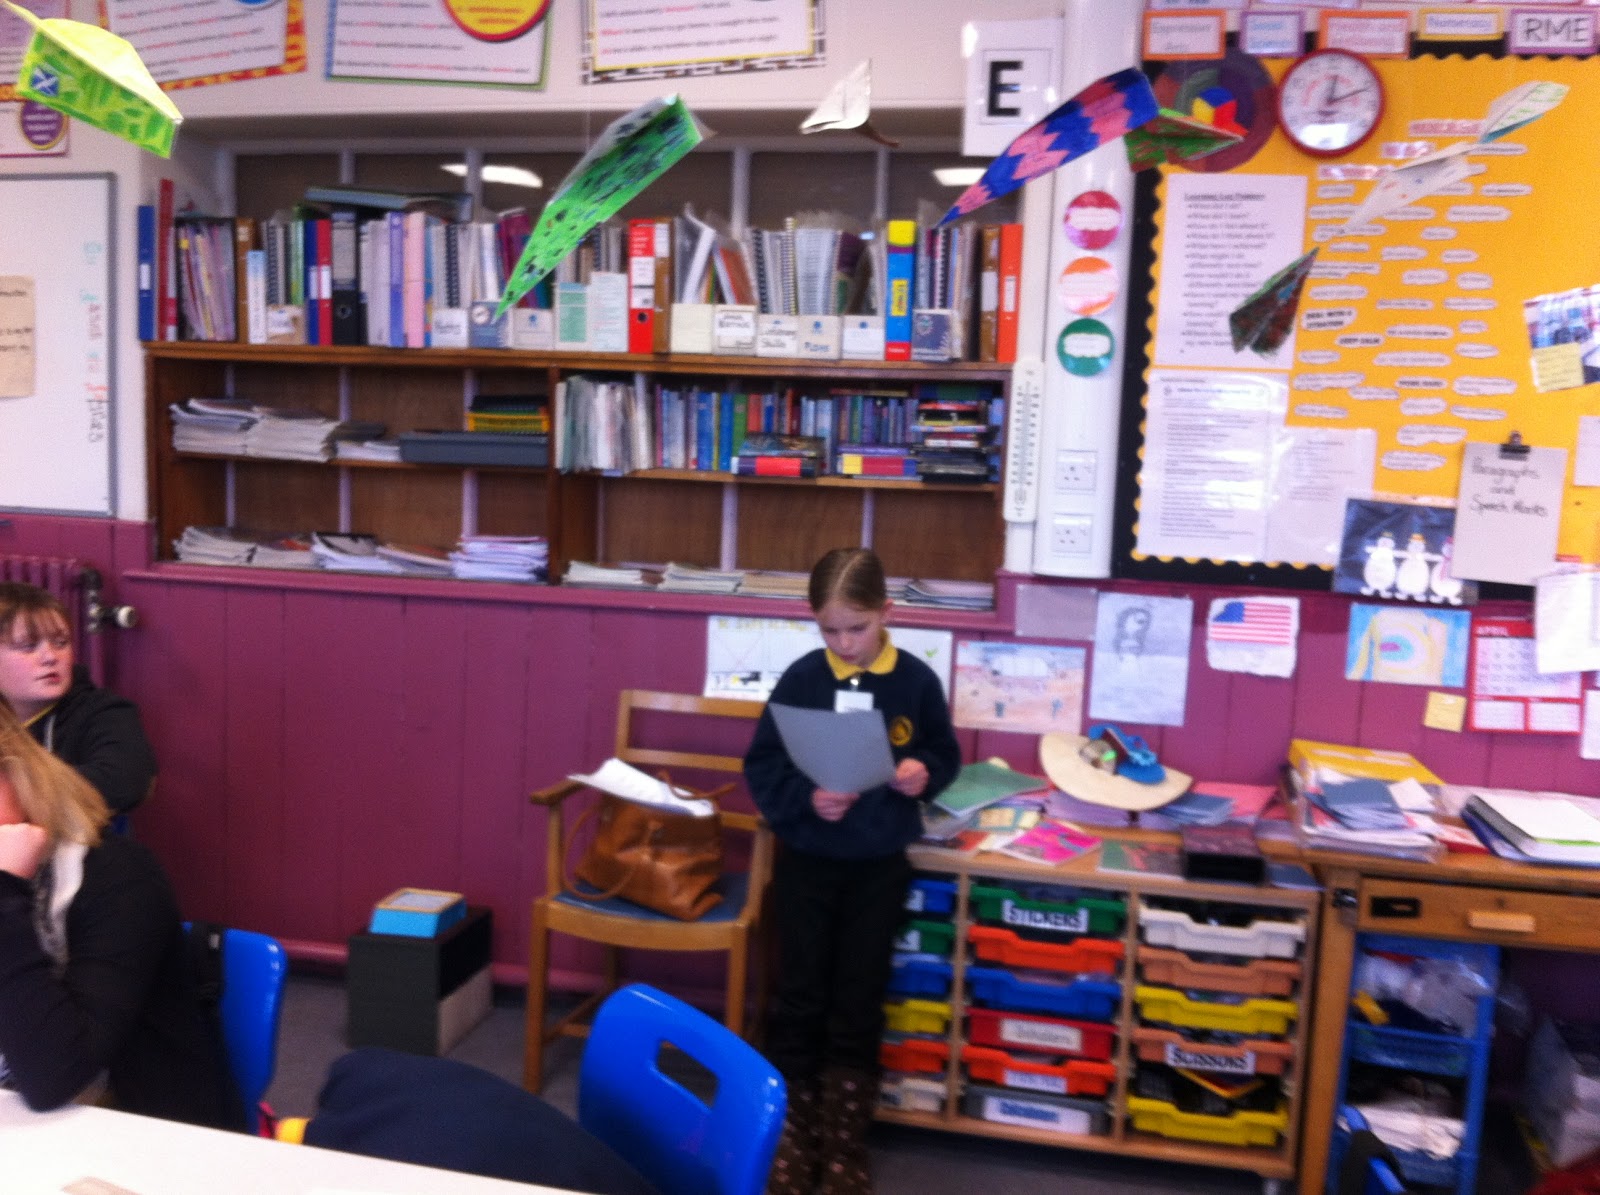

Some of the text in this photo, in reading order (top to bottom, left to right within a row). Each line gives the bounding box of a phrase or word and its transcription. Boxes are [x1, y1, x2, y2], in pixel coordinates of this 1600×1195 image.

[1524, 17, 1589, 43] RME
[988, 60, 1023, 117] E
[1490, 485, 1516, 495] and
